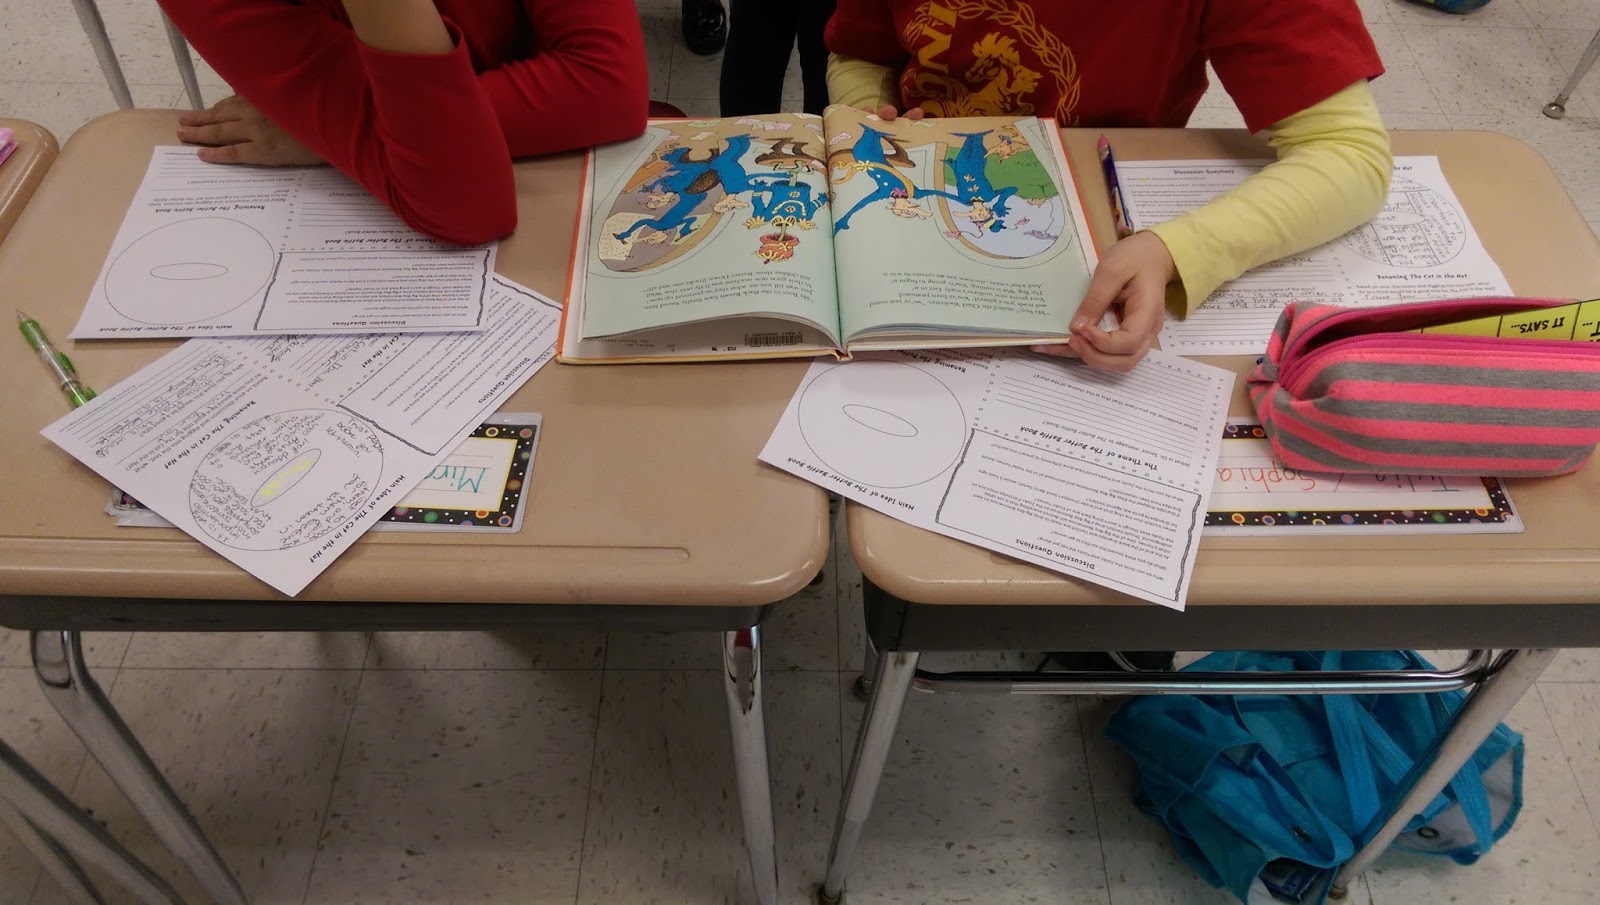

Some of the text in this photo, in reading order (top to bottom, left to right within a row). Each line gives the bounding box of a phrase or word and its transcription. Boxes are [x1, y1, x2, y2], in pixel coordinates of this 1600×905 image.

[1510, 316, 1565, 334] IT SAYS...
[360, 333, 400, 369] Cat in the Hat
[477, 355, 530, 404] Discussion Questions
[163, 398, 256, 470] Renaming The Cat in the Hat
[1019, 425, 1158, 471] The Theme of The Butter Battle Book
[786, 456, 914, 510] Main Idea of The Butter Battle Book
[1215, 458, 1316, 493] Sophia
[308, 473, 405, 563] Main Idea of The Cat in the Hat
[1014, 538, 1095, 569] Discussion Questions
